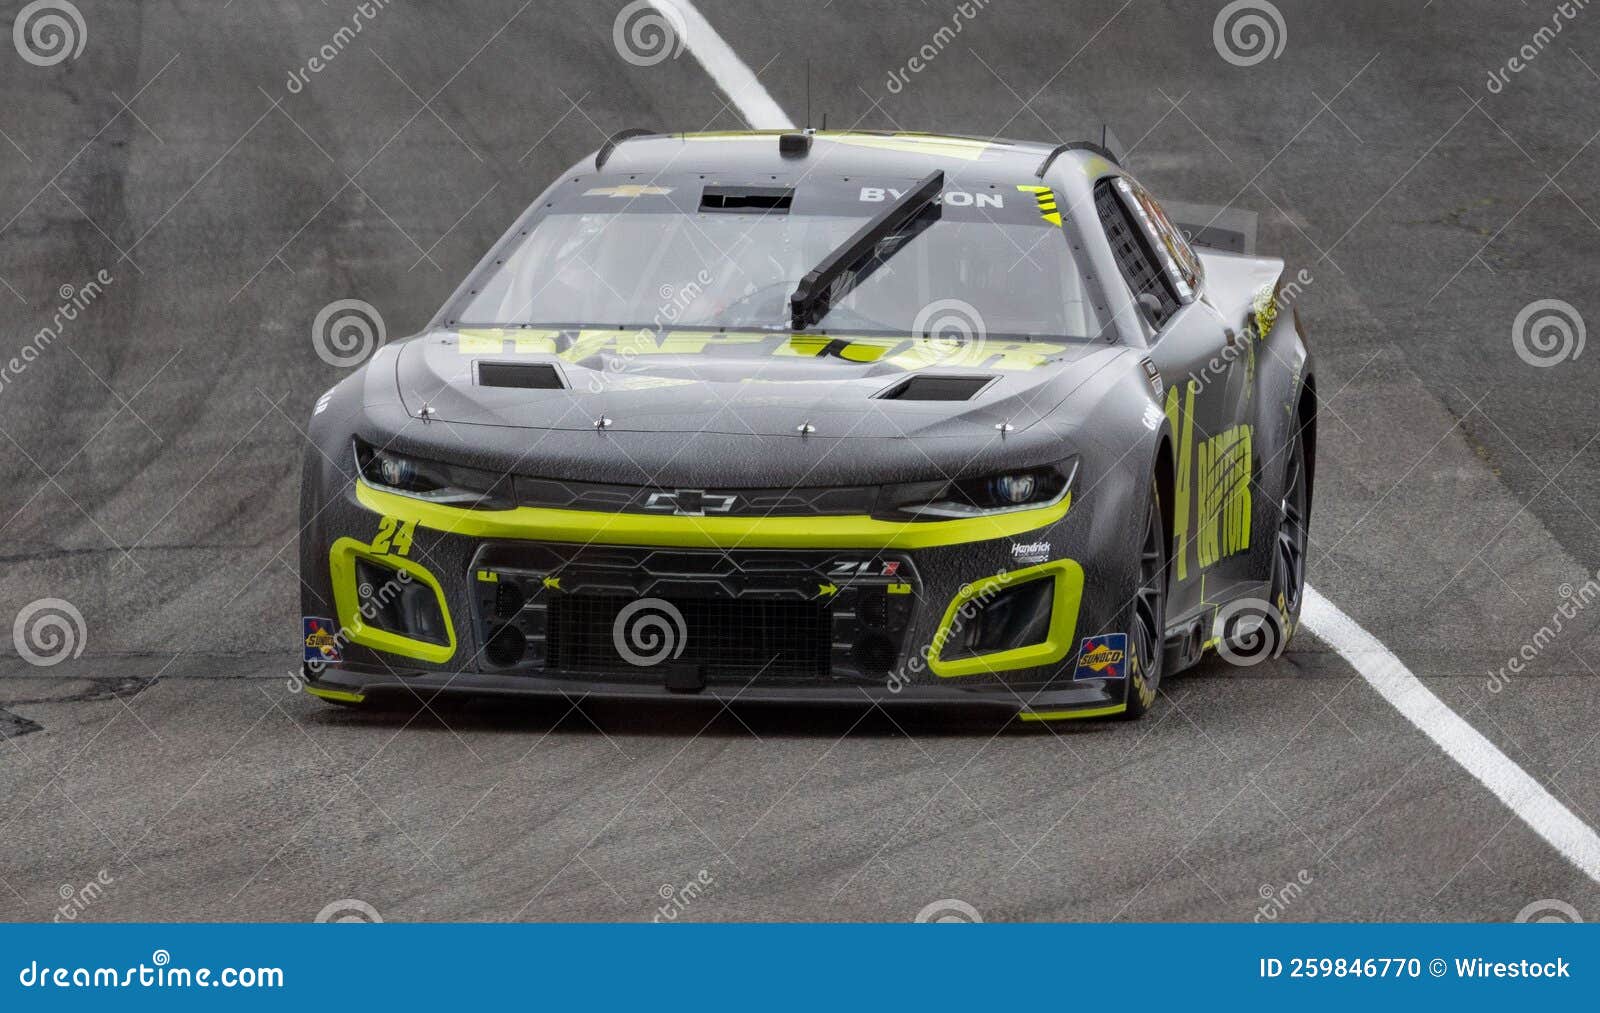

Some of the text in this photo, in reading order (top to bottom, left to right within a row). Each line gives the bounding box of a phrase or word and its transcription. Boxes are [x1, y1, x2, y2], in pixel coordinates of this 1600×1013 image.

[859, 187, 1004, 209] BYON
[371, 514, 420, 556] 24
[1011, 541, 1050, 557] Hendrick
[828, 561, 900, 576] ZL1
[1080, 650, 1120, 665] SUNOCO
